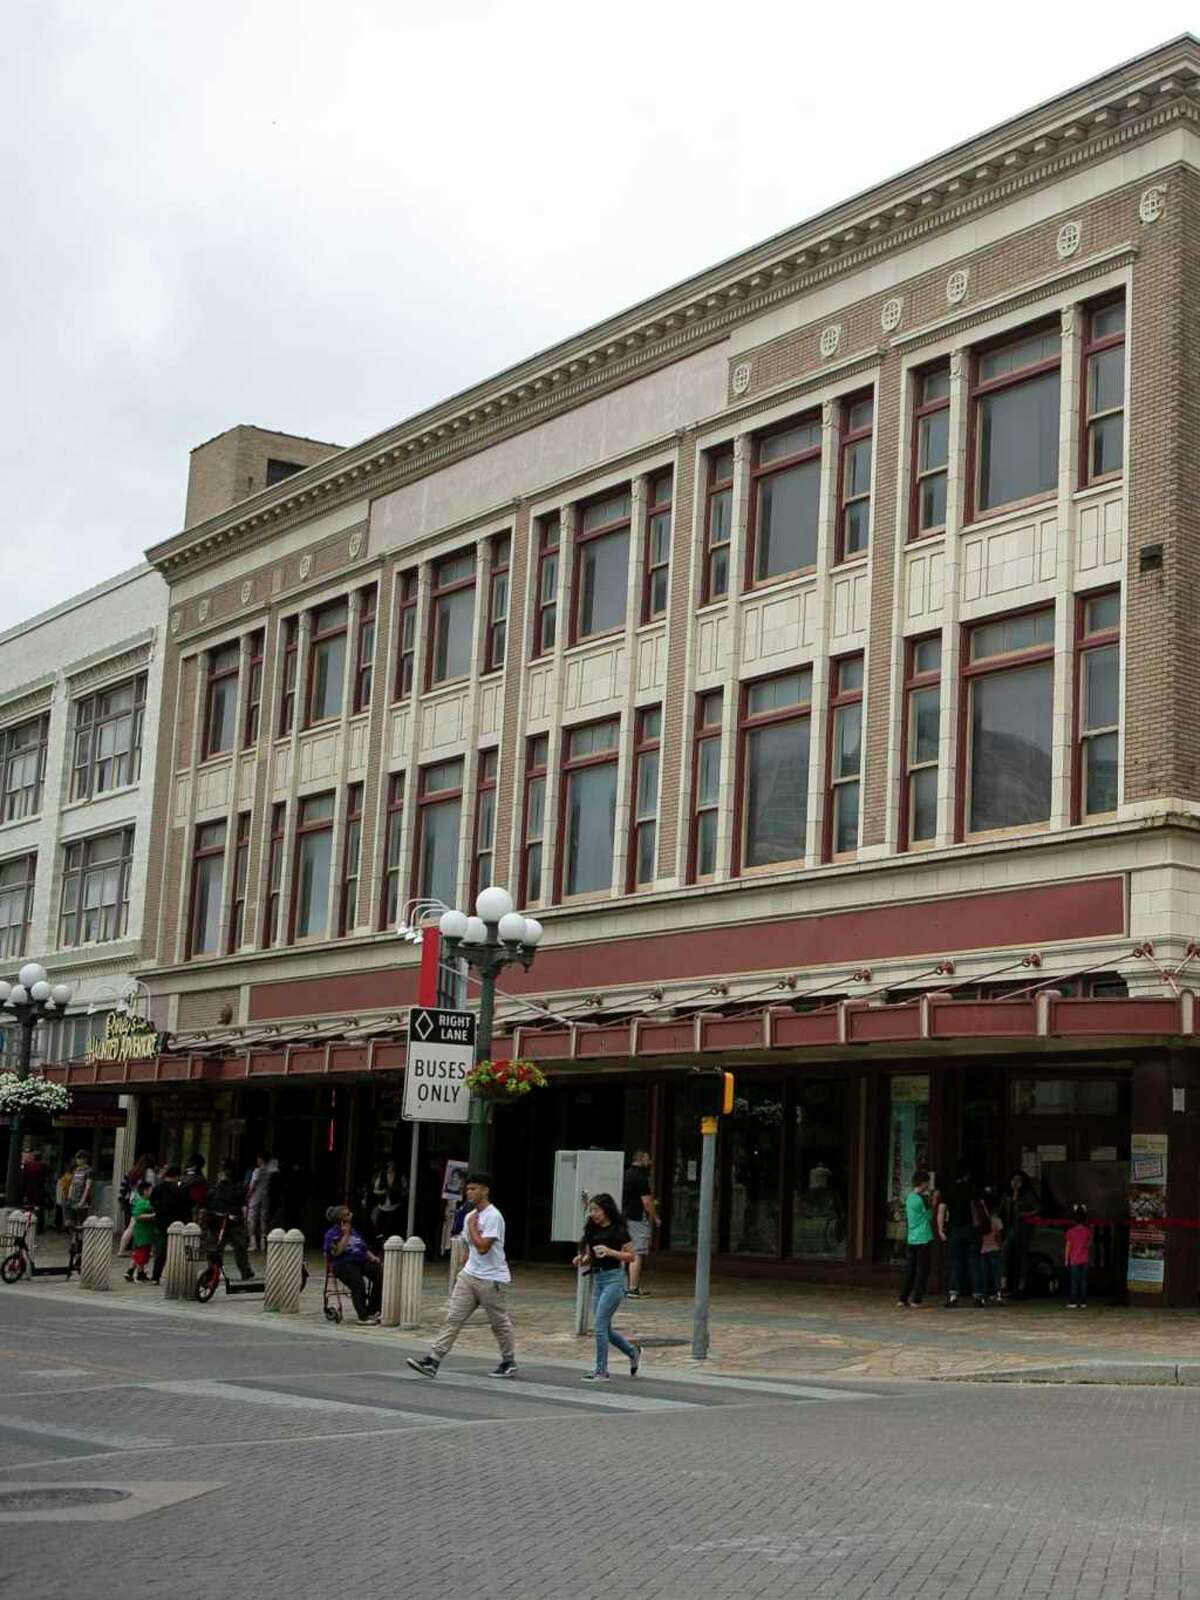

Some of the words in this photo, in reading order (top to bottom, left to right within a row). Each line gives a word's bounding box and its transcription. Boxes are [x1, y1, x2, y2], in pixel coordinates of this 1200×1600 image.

[438, 1015, 471, 1028] RIGHT
[440, 1028, 468, 1041] LANE
[414, 1059, 466, 1080] BUSES
[417, 1083, 460, 1103] ONLY
